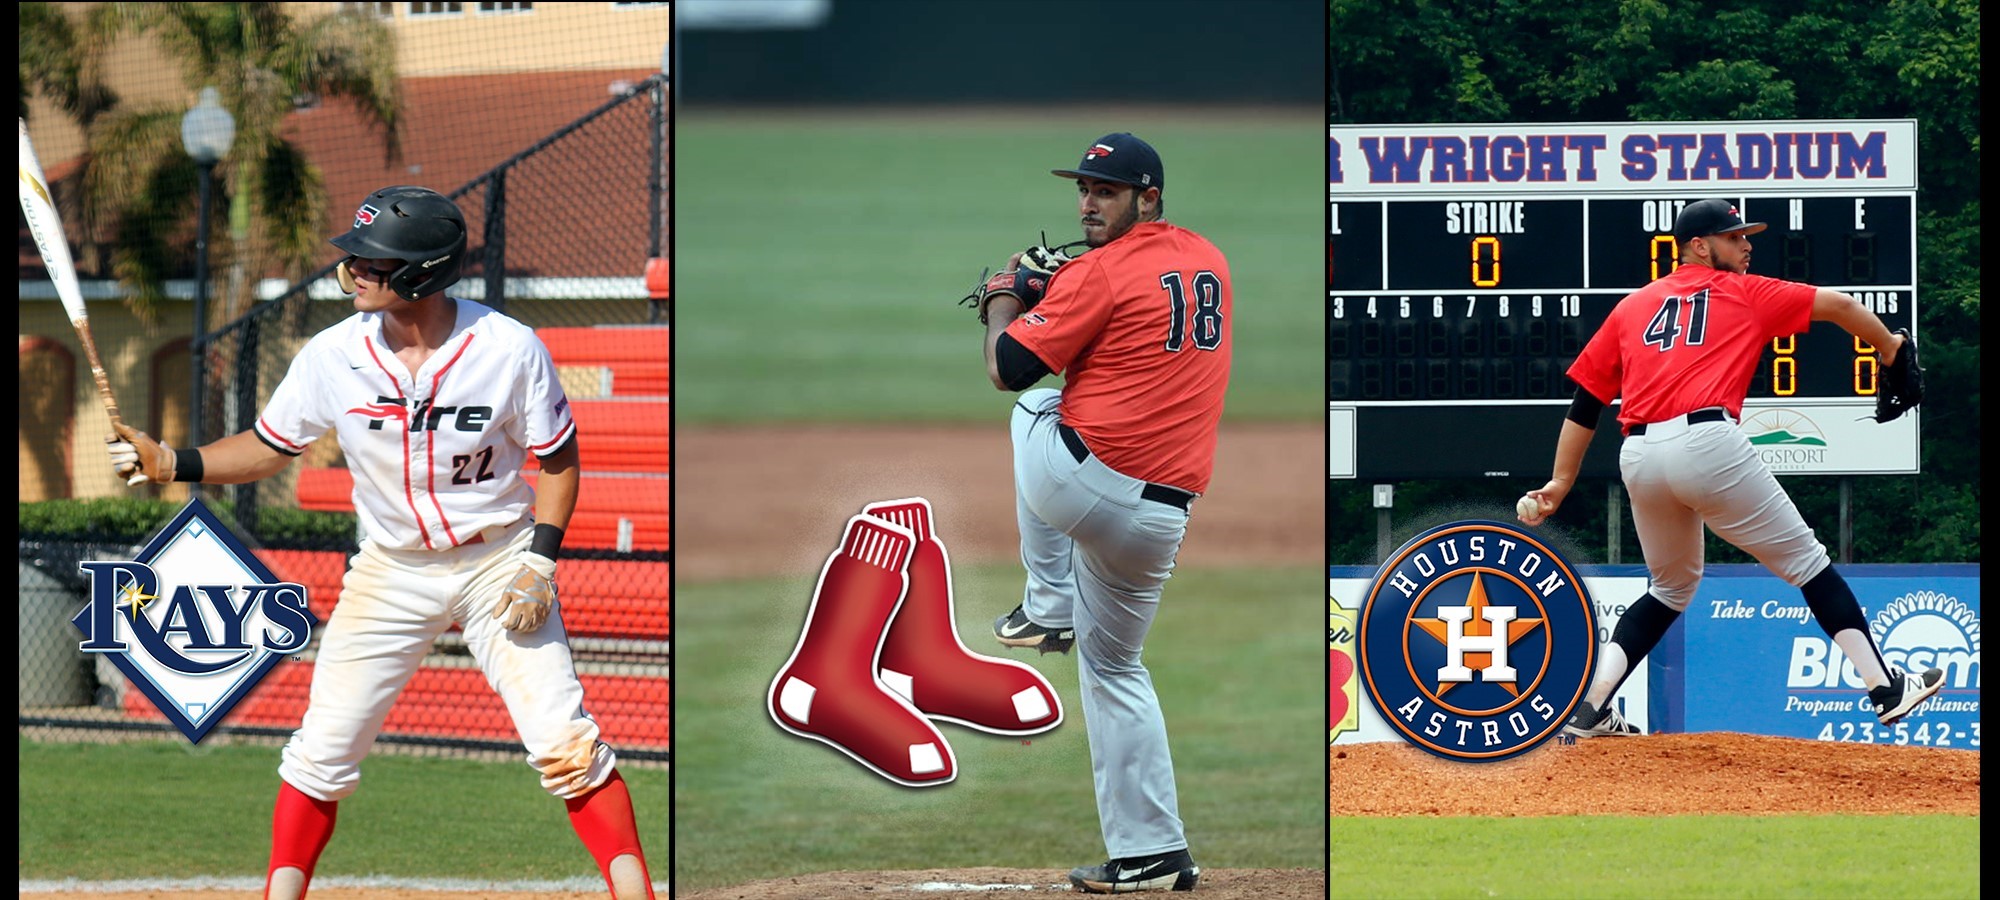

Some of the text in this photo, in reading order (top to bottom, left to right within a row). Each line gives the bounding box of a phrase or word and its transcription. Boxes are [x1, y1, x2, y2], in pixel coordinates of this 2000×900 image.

[1359, 135, 1607, 184] WRIGHT
[1621, 131, 1887, 181] STADIUM
[1446, 202, 1525, 233] STRIKE
[1643, 200, 1686, 232] OUT
[1789, 199, 1865, 230] H E
[1472, 237, 1499, 286] 0
[1160, 271, 1223, 351] 18
[1333, 296, 1580, 318] 3 4 5 6 7 8 9 10
[1853, 292, 1898, 314] ORS
[1643, 288, 1710, 352] 41
[1773, 356, 1796, 396] 0
[1855, 355, 1877, 394] 0
[346, 395, 494, 432] Fire
[451, 445, 495, 485] 22
[1757, 448, 1828, 464] GSPORT
[1596, 600, 1627, 617] ive
[1710, 600, 1816, 625] Take Comf
[1784, 696, 1853, 717] Propane
[1906, 695, 1979, 719] pliance
[1817, 722, 1980, 746] 423-542-3
